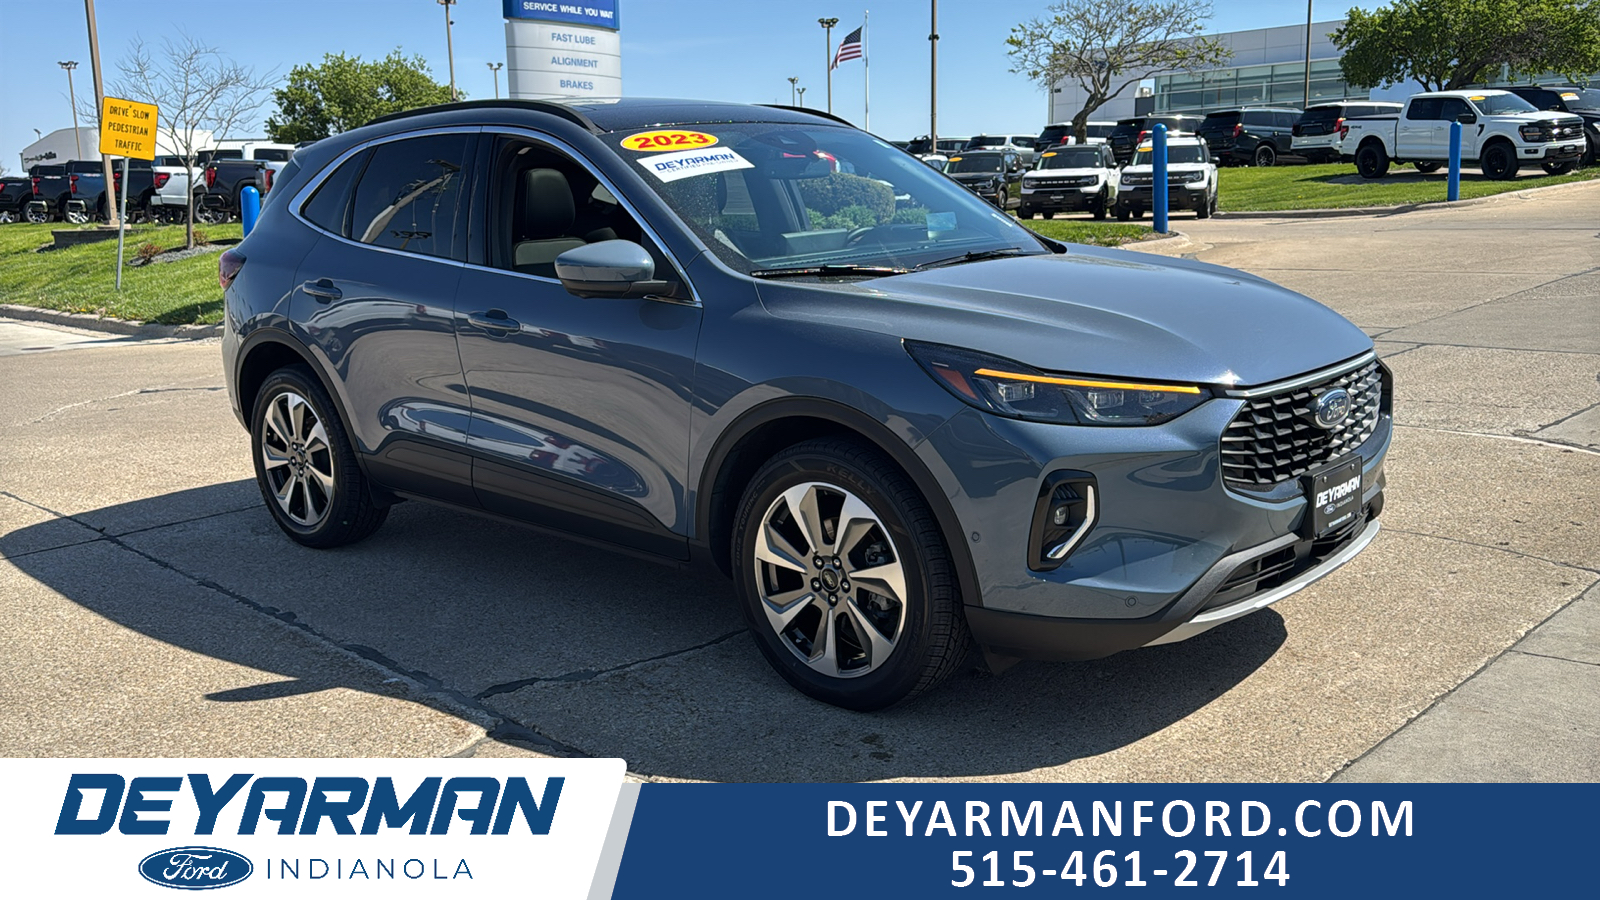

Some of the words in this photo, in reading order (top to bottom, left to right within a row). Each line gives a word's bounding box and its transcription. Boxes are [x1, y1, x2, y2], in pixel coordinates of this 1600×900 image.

[523, 1, 558, 12] SERVICE
[560, 4, 583, 15] WHILE
[584, 7, 598, 17] YOU
[600, 9, 613, 18] WAIT
[551, 32, 573, 43] FAST
[575, 35, 596, 45] LUBE
[551, 56, 598, 68] ALIGNMENT
[559, 79, 594, 90] BRAKES
[109, 105, 129, 117] DRIVE
[132, 109, 150, 120] SLOW
[108, 121, 149, 136] PEDESTRIAN
[115, 139, 142, 151] TRAFFIC
[633, 133, 710, 149] 2023
[654, 153, 735, 172] DEYARMAN
[826, 465, 877, 495] KELLY
[1316, 475, 1360, 508] DEYARMAN
